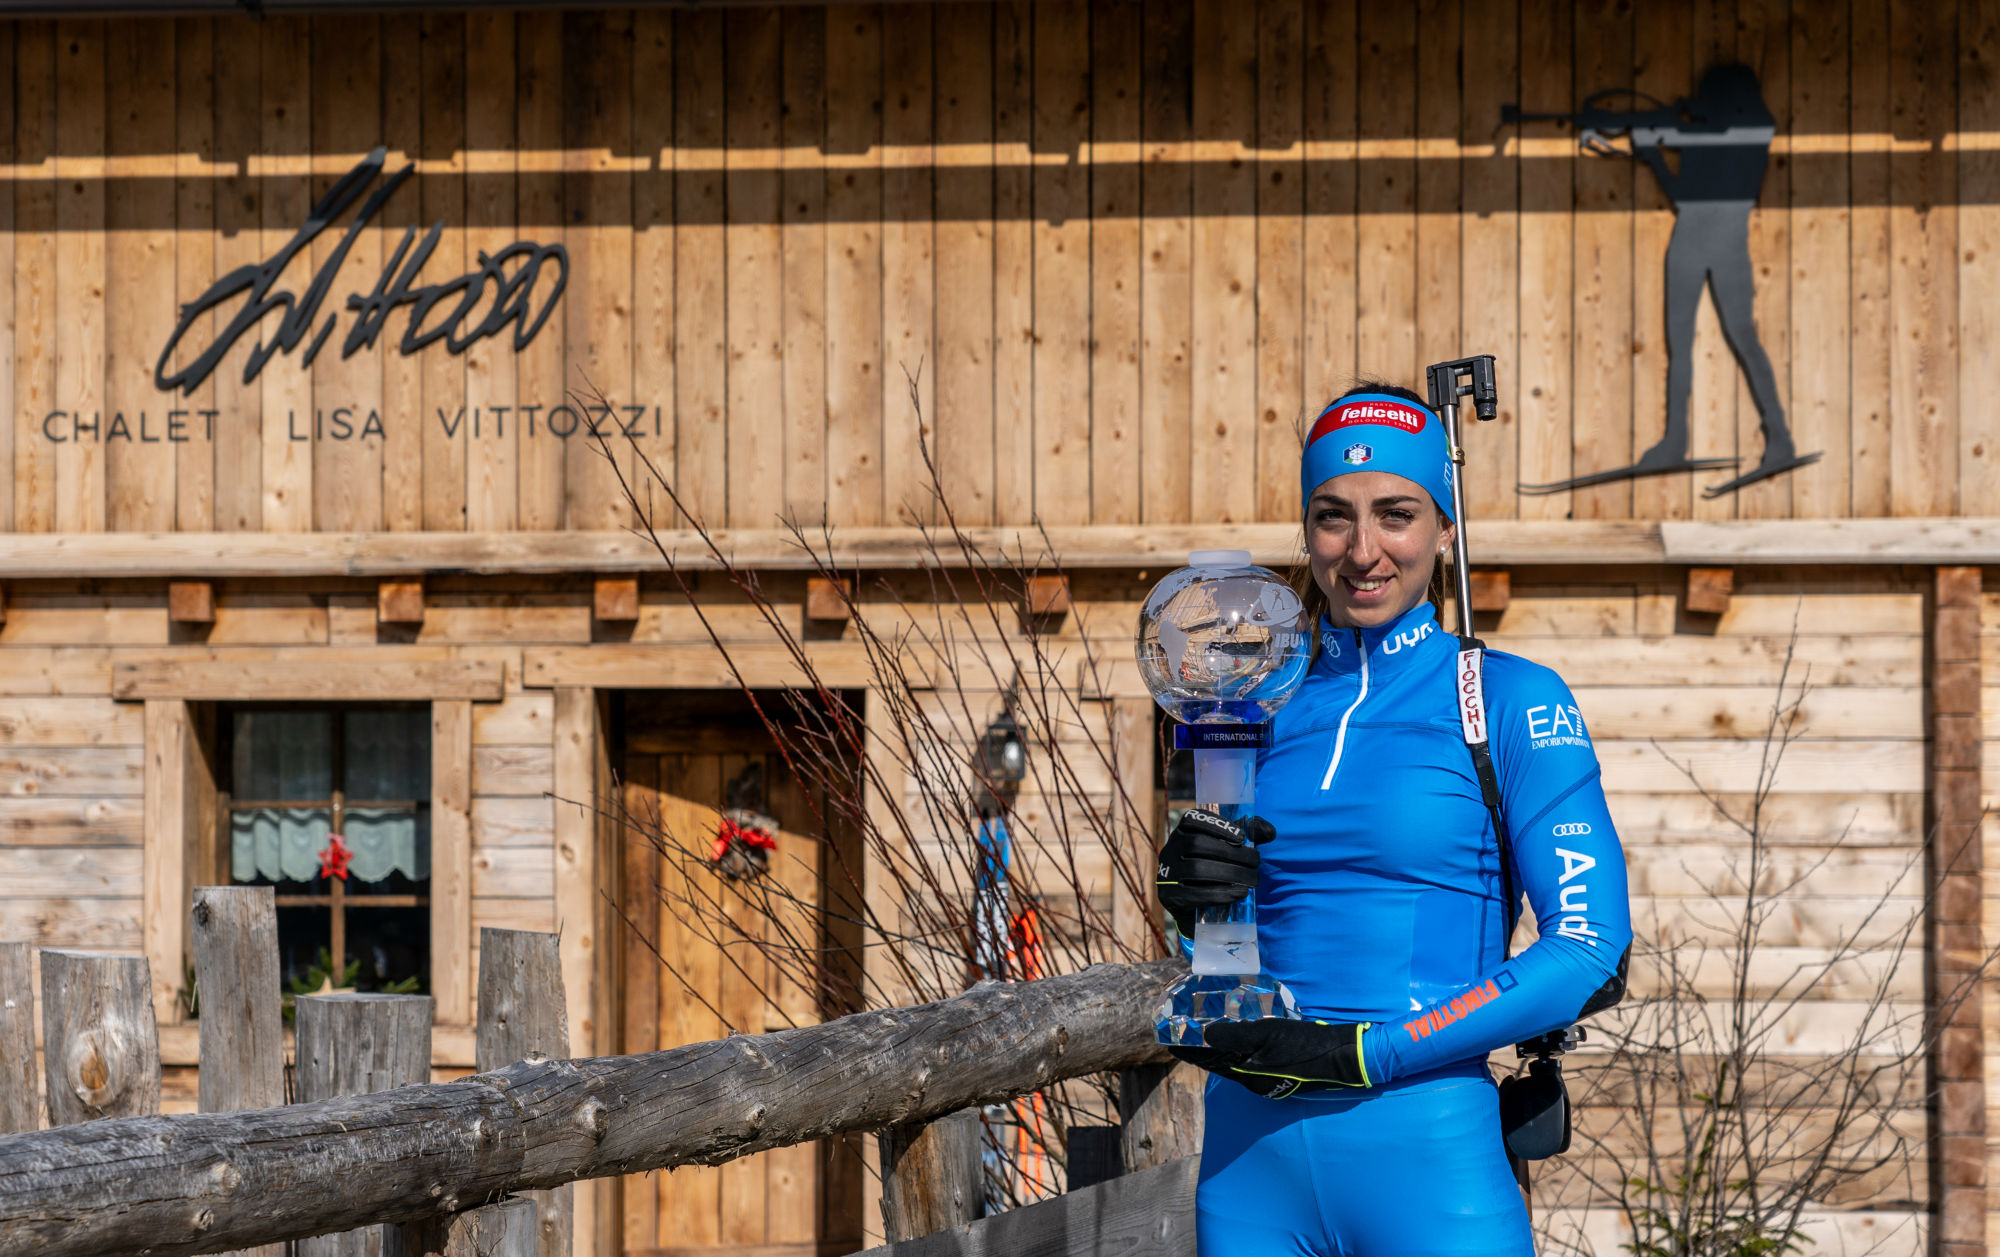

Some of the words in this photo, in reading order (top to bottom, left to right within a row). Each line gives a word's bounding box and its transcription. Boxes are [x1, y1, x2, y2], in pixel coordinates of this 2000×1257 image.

[43, 409, 220, 443] CHALET
[288, 408, 386, 440] LISA
[437, 405, 661, 438] VITTOZZI
[1340, 406, 1418, 428] felicetti
[1462, 651, 1480, 739] FIOCCHI
[1526, 703, 1583, 739] EA7
[1555, 847, 1598, 947] Audi
